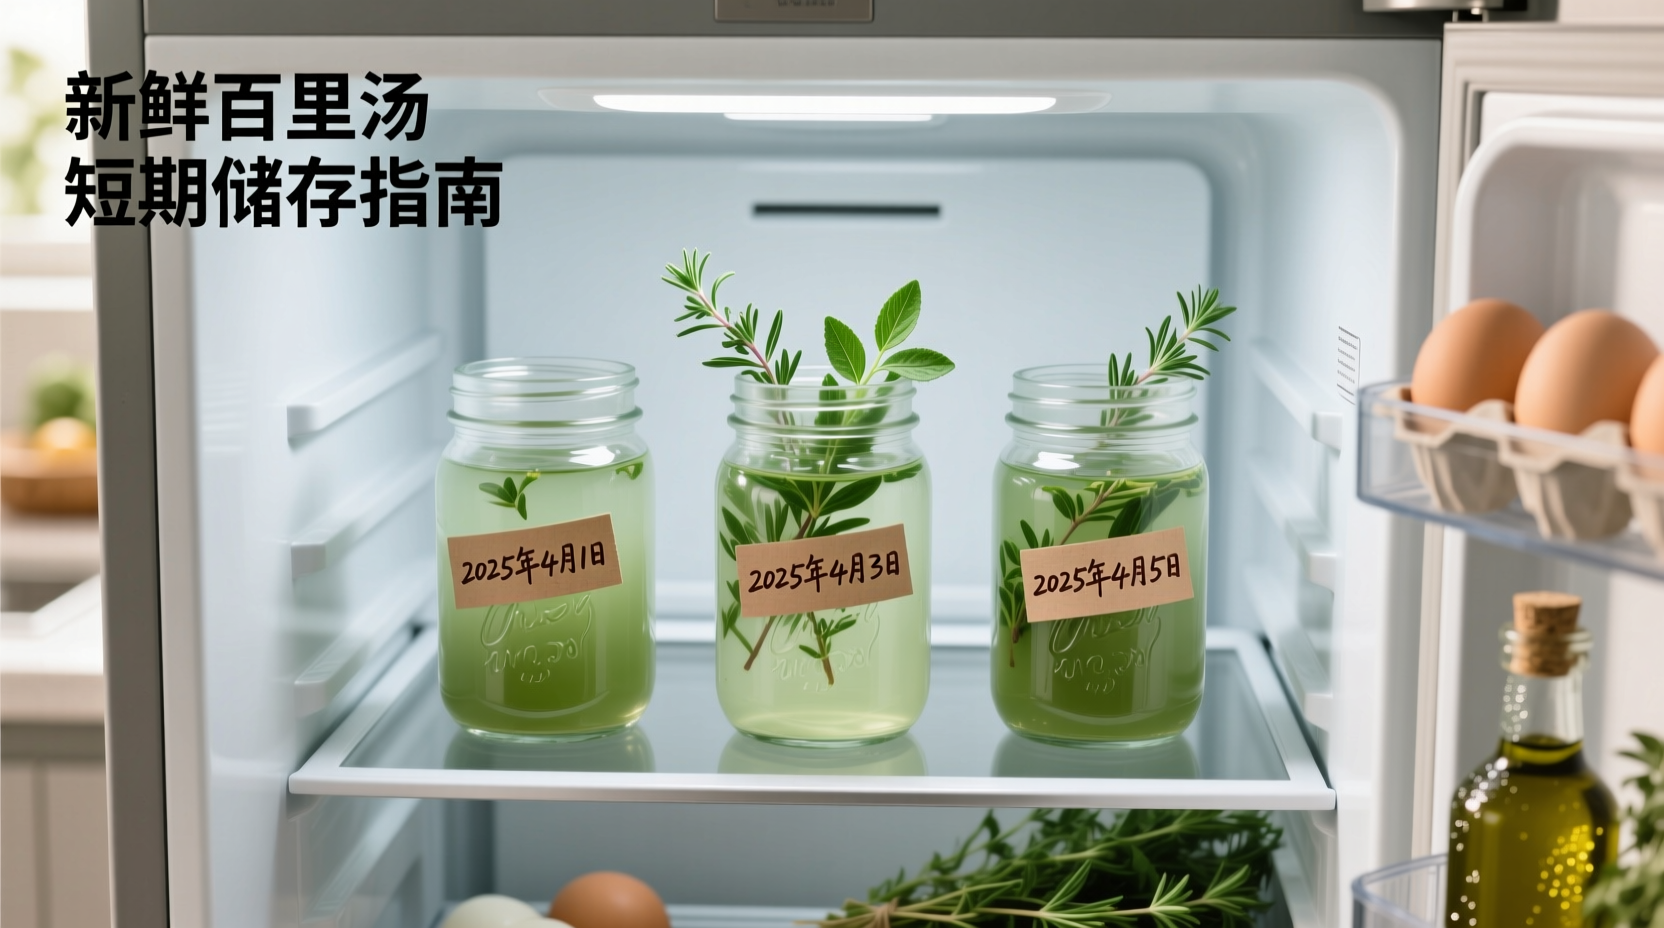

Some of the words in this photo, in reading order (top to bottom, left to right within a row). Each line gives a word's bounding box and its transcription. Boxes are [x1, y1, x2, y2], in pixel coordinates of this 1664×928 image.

[461, 541, 605, 585] 2025年4月1日
[748, 550, 900, 593] 2025年4月3日
[1033, 553, 1181, 597] 2025年4月5日
